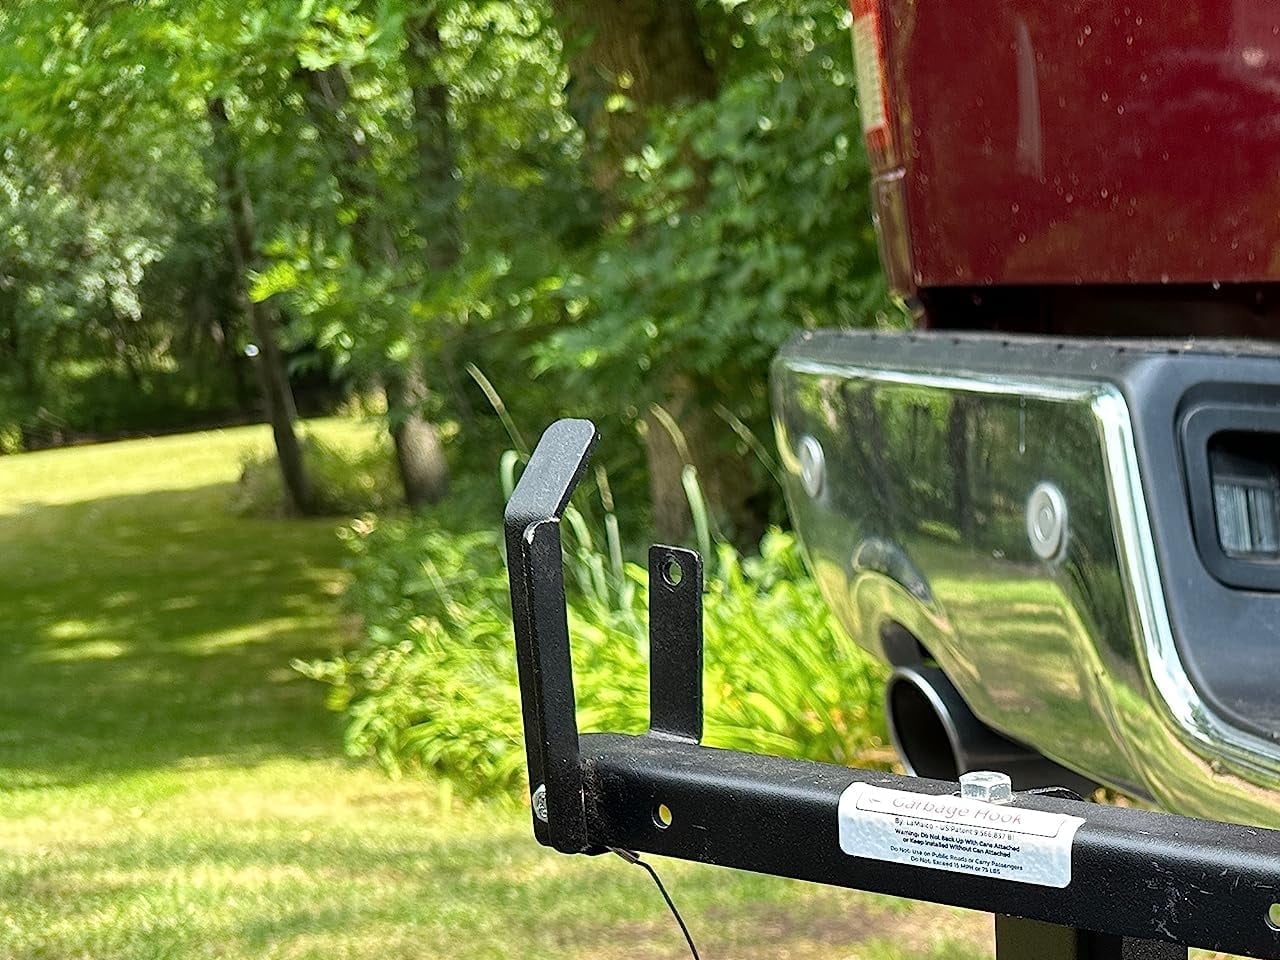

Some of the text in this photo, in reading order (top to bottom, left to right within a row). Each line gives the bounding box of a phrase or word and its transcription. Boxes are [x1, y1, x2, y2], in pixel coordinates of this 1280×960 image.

[974, 809, 1021, 824] Hook
[994, 843, 1020, 853] Attached
[985, 849, 1011, 858] Attached
[991, 860, 1023, 871] Passengers
